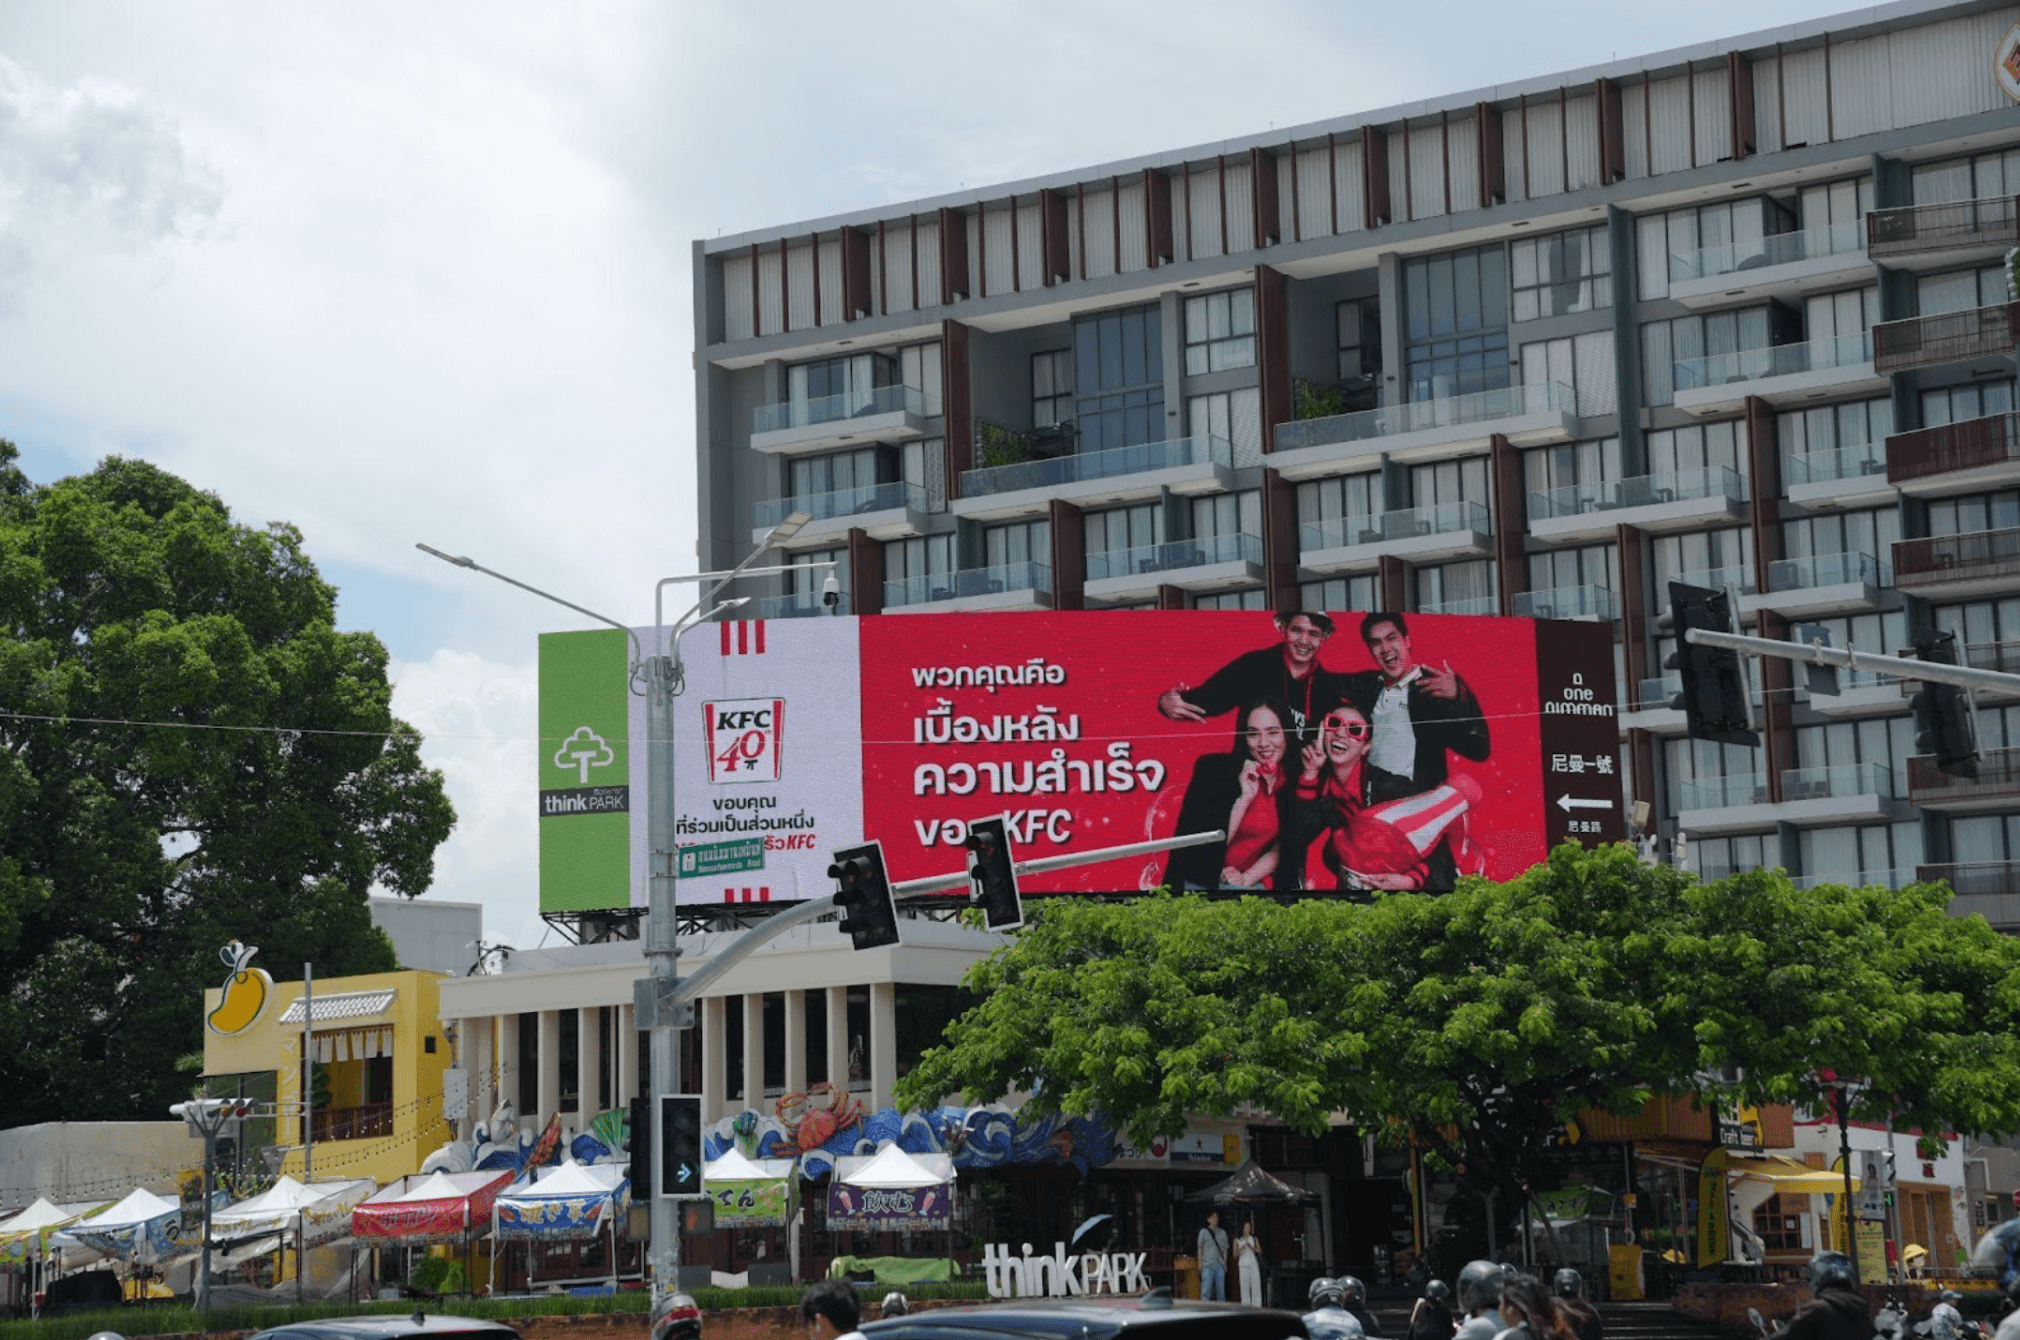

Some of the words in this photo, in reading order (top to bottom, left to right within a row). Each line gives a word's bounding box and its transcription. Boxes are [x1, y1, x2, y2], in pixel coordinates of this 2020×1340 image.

[912, 658, 1065, 693] พวกคุณคือ
[1563, 687, 1594, 701] one
[716, 709, 771, 730] KFC
[913, 697, 1080, 744] เบื้องหลัง
[913, 741, 1165, 795] ความสำเร็จ
[712, 796, 777, 814] ขอบคุณ
[913, 818, 967, 846] ขอ
[1003, 808, 1073, 844] KFC
[981, 1241, 1083, 1299] think
[1081, 1252, 1150, 1295] PARK
